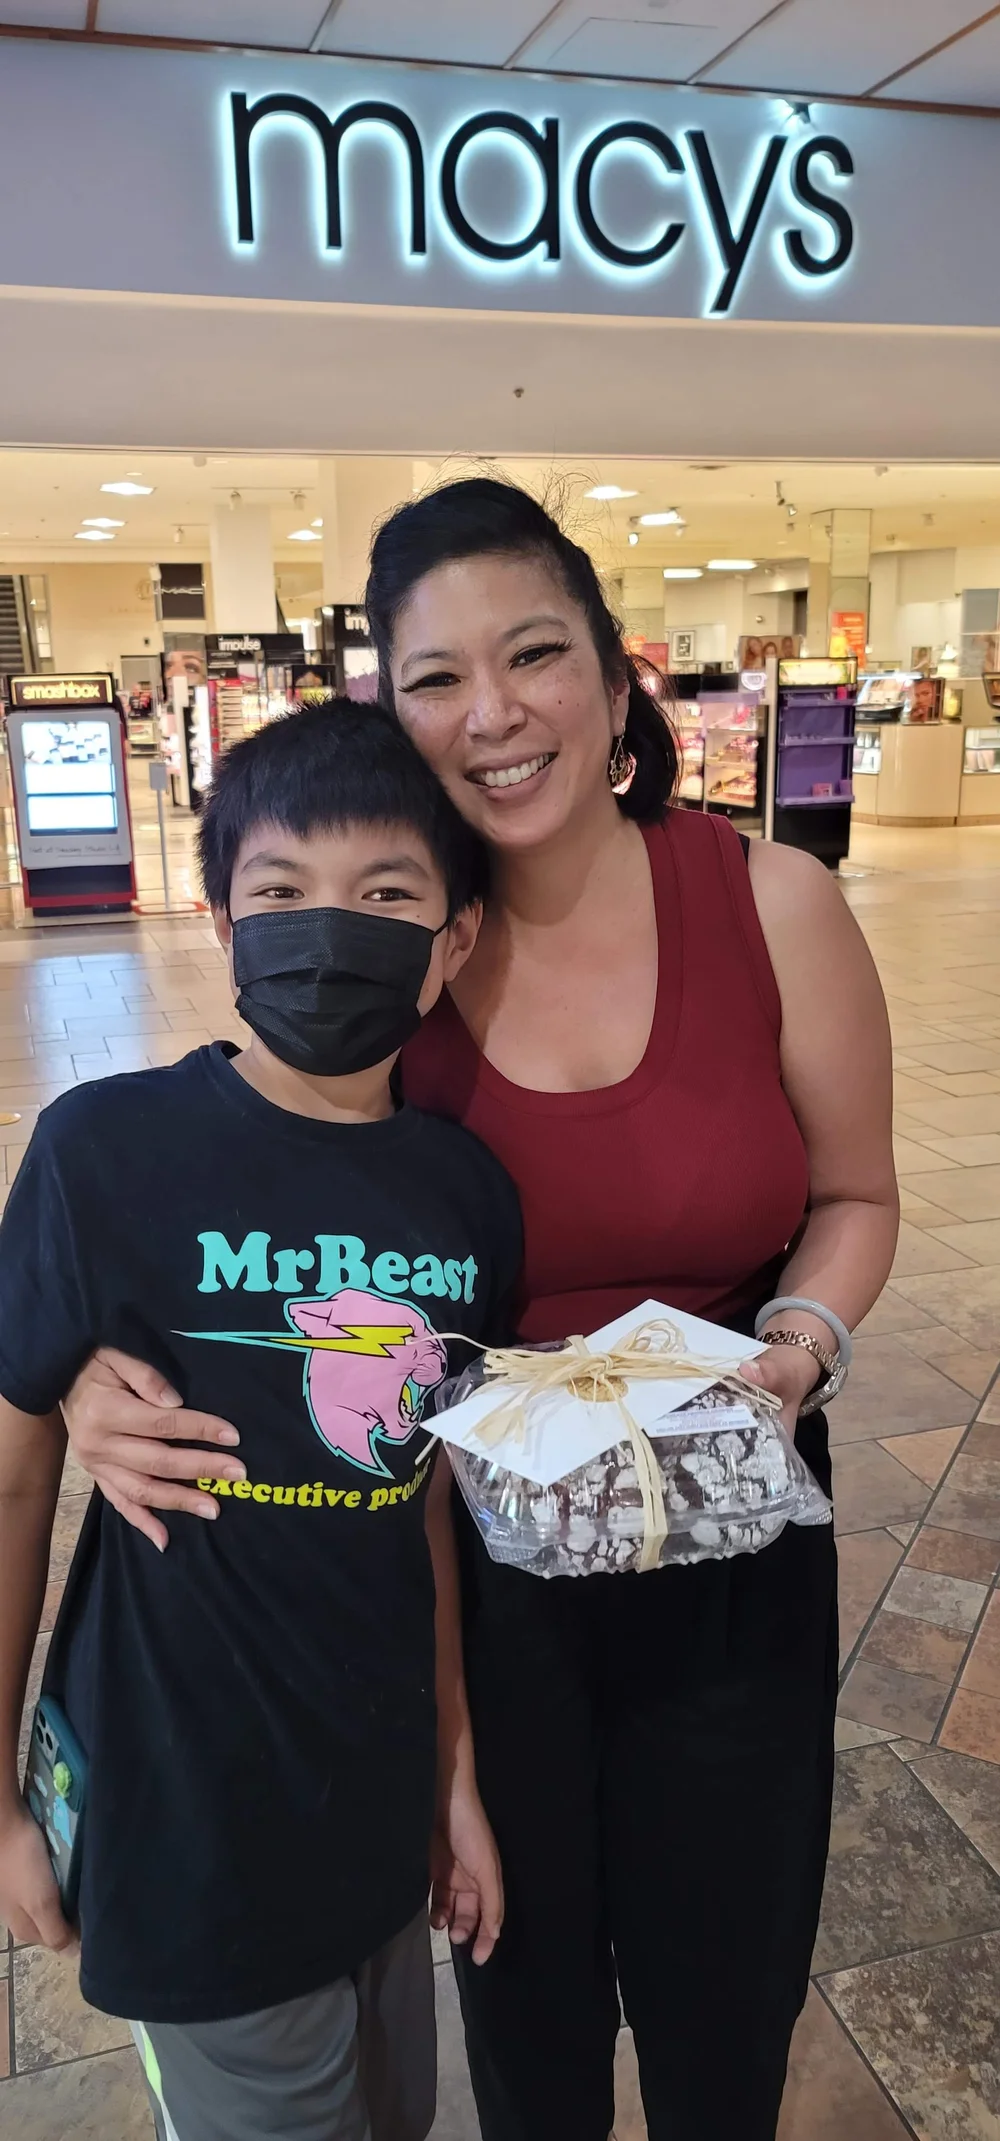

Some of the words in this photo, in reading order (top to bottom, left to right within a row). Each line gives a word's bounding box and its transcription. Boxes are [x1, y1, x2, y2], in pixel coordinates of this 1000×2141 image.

[231, 91, 854, 314] macys
[218, 635, 262, 651] impulse
[22, 681, 101, 700] smashbox
[197, 1231, 479, 1305] MrBeast
[197, 1478, 362, 1509] executive
